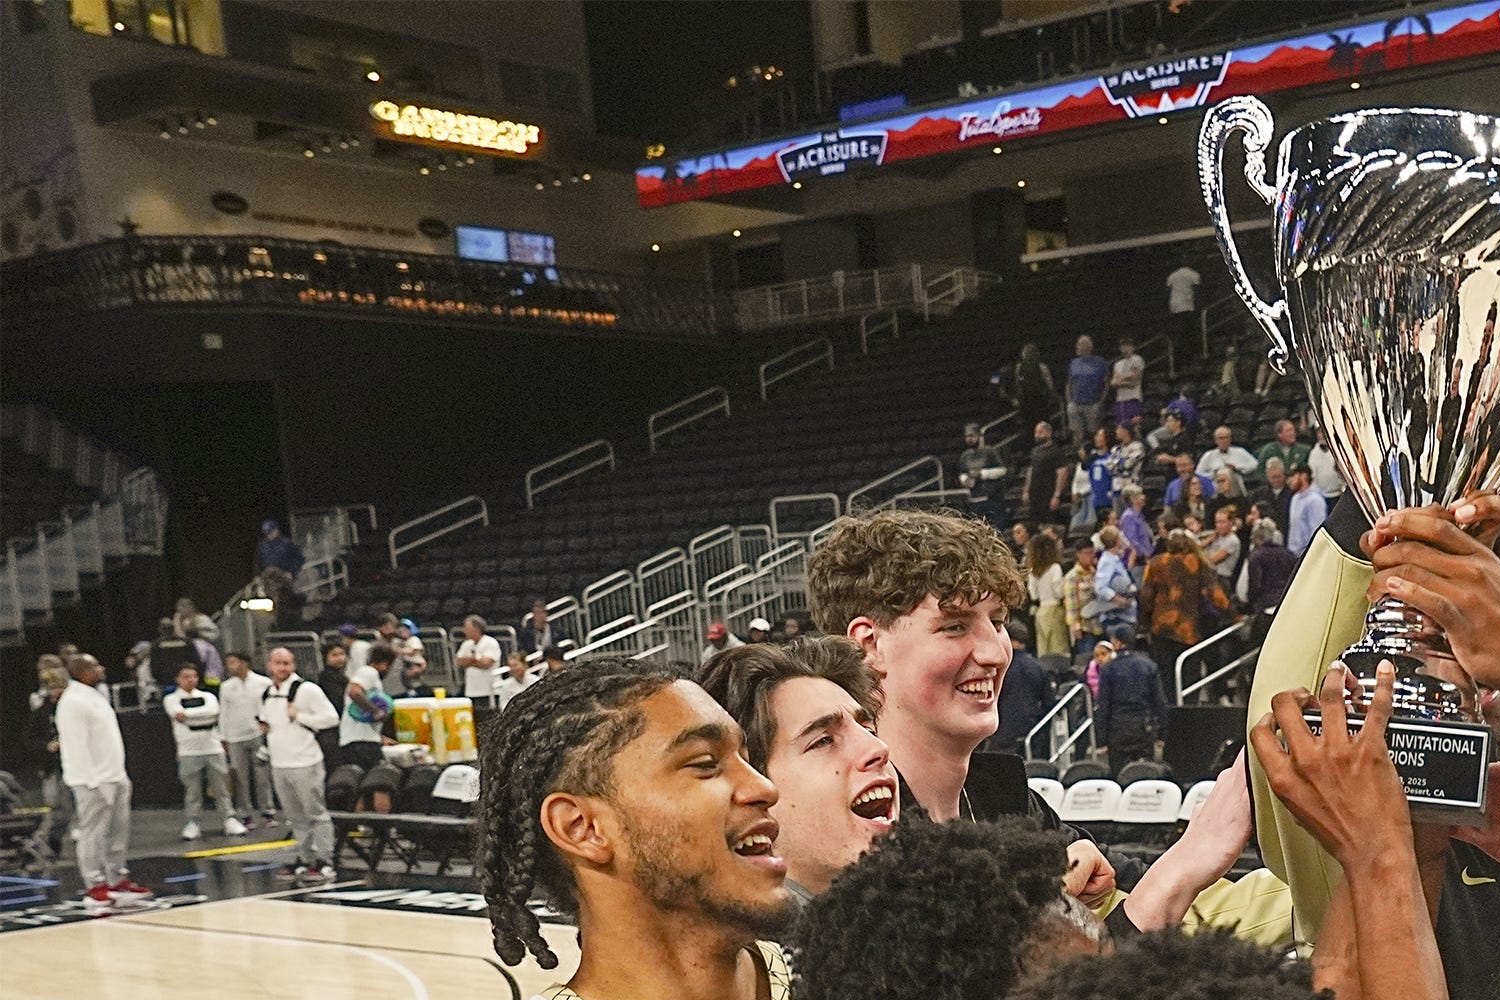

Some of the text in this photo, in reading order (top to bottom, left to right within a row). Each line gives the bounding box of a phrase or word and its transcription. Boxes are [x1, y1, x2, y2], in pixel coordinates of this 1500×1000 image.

[797, 139, 869, 171] ACRISURE
[1391, 732, 1477, 756] INVITATIONAL
[1407, 776, 1427, 787] 2025
[1433, 789, 1445, 798] CA
